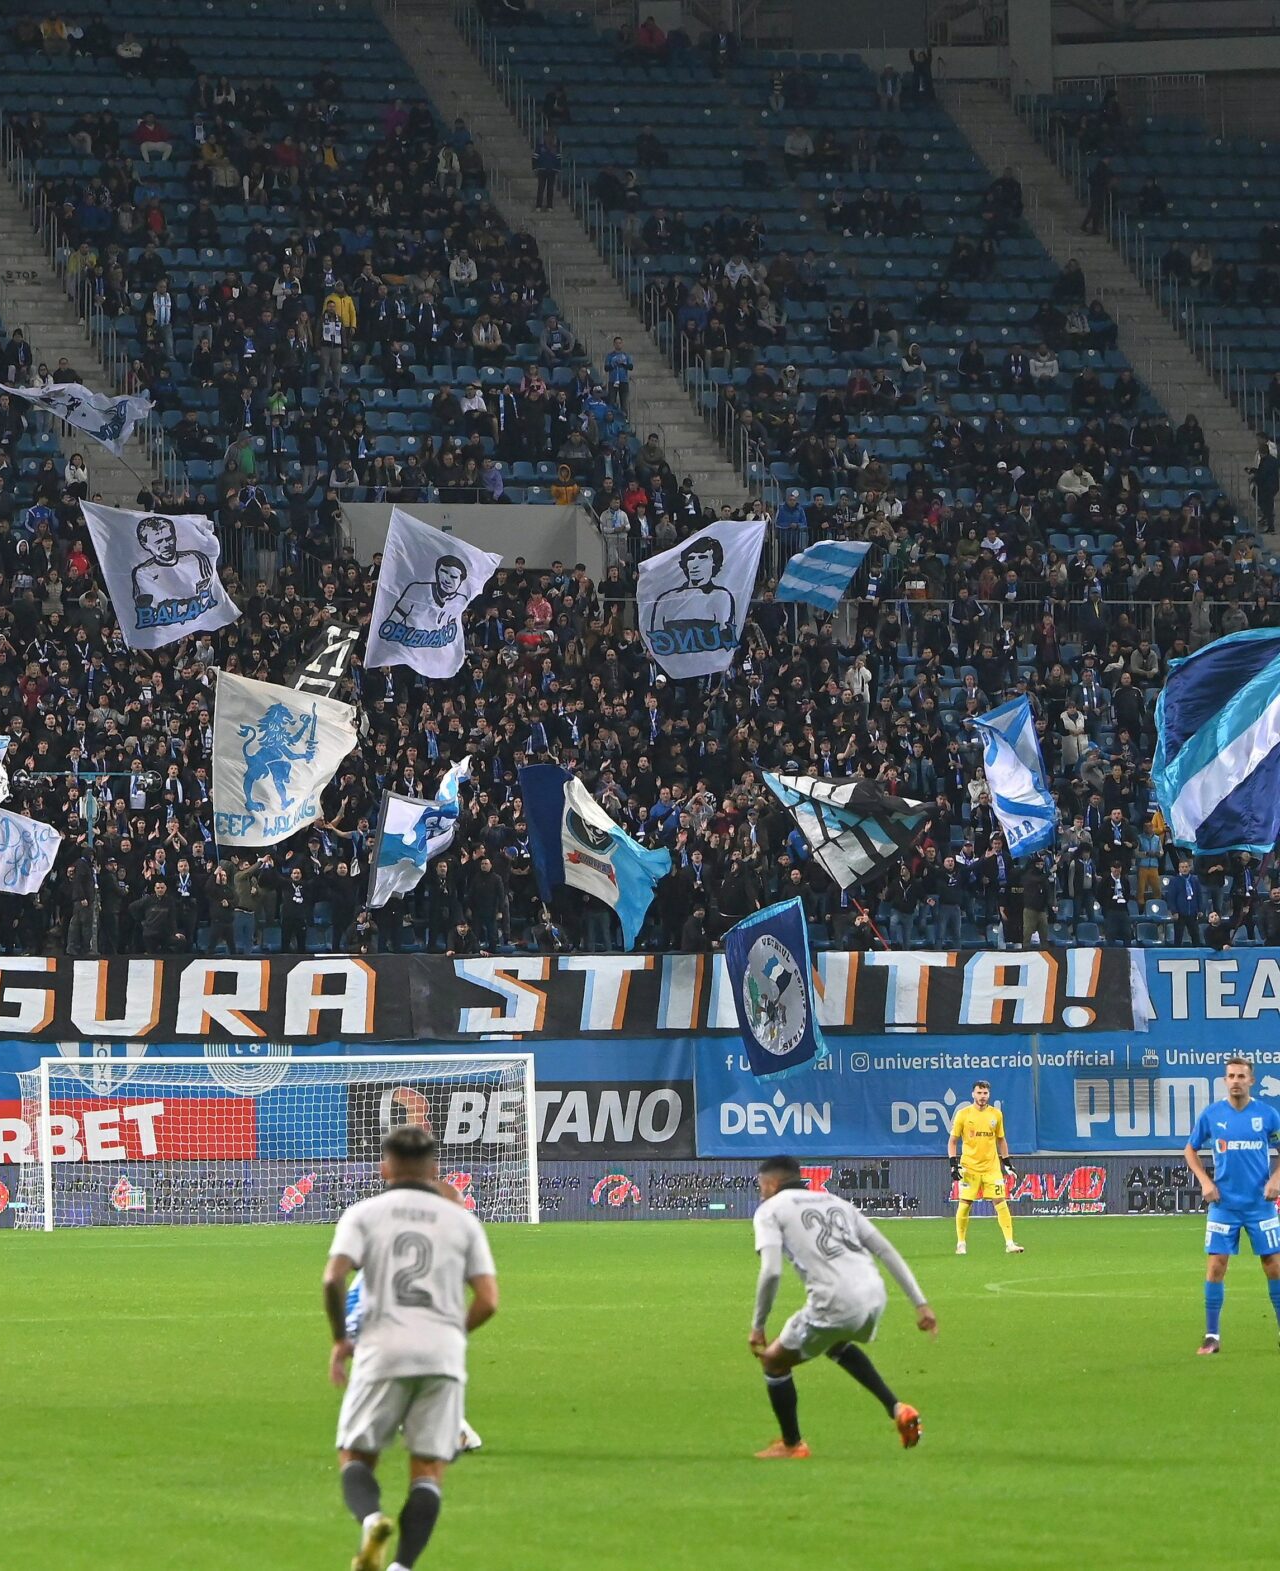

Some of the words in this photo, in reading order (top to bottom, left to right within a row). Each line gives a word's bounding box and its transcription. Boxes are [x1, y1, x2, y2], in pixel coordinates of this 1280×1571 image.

[213, 811, 256, 837] EEP
[1150, 958, 1280, 1020] TEA
[443, 1088, 682, 1145] BETANO
[720, 1101, 832, 1136] DEVIN
[1074, 1078, 1226, 1138] PUM
[1228, 1140, 1263, 1150] BETANO
[838, 1160, 891, 1190] ani
[392, 1231, 433, 1307] 2
